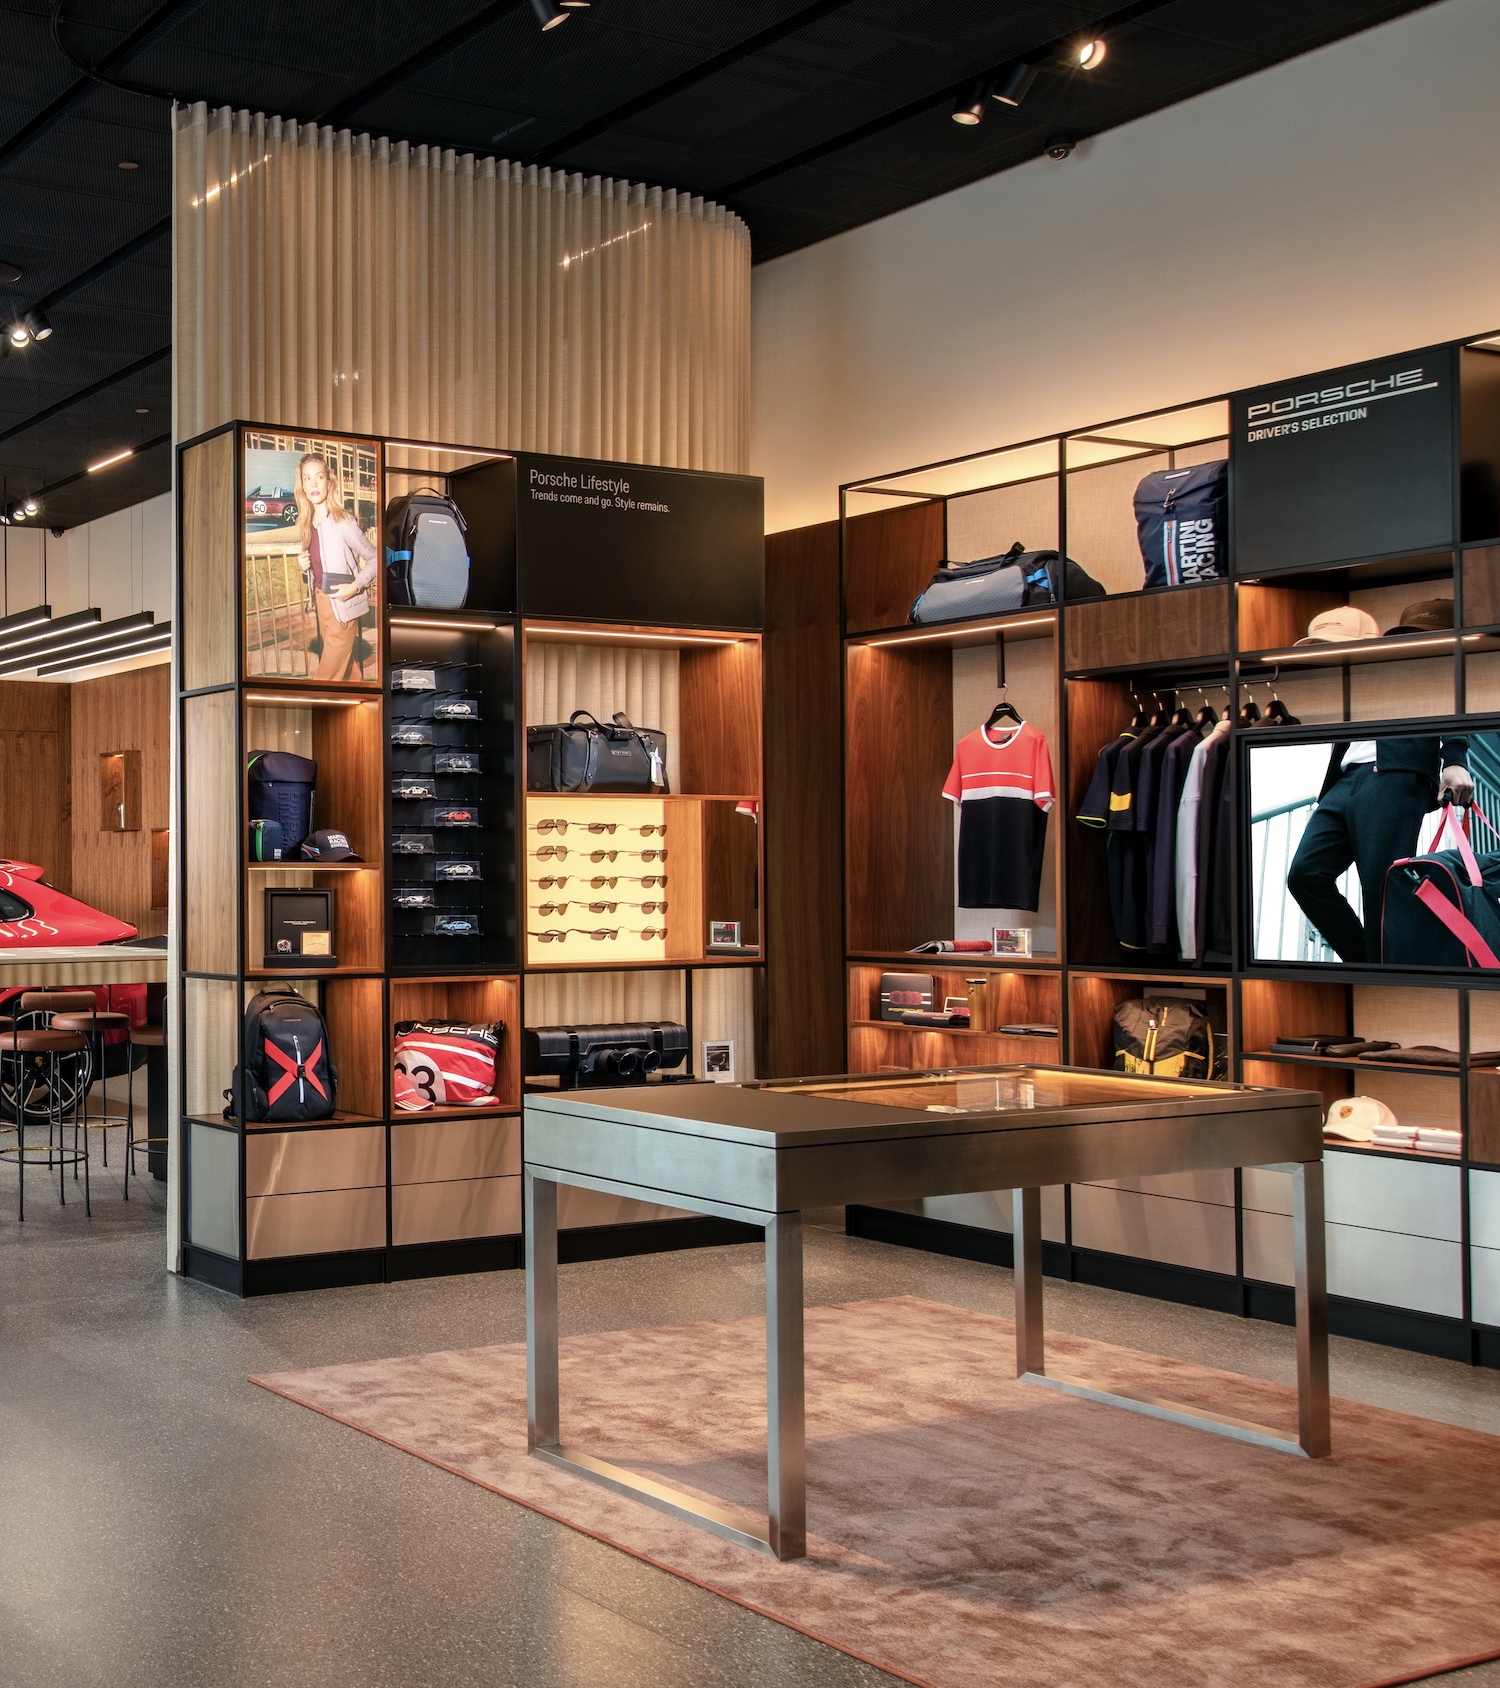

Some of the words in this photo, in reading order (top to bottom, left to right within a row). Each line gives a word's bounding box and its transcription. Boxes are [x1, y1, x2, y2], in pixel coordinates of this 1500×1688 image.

[1247, 368, 1424, 420] PORSCHE
[1247, 421, 1300, 443] DRIVER'S
[1300, 407, 1368, 432] SELECTION
[530, 468, 578, 488] Porsche
[580, 474, 630, 496] Lifestyle
[254, 503, 266, 513] 50
[530, 488, 559, 502] Trends
[560, 494, 583, 504] come
[584, 495, 600, 506] and
[601, 498, 614, 509] go.
[614, 497, 636, 511] Style
[637, 501, 671, 513] remains.
[1194, 518, 1220, 582] ACING
[395, 1023, 499, 1045] RSCHE
